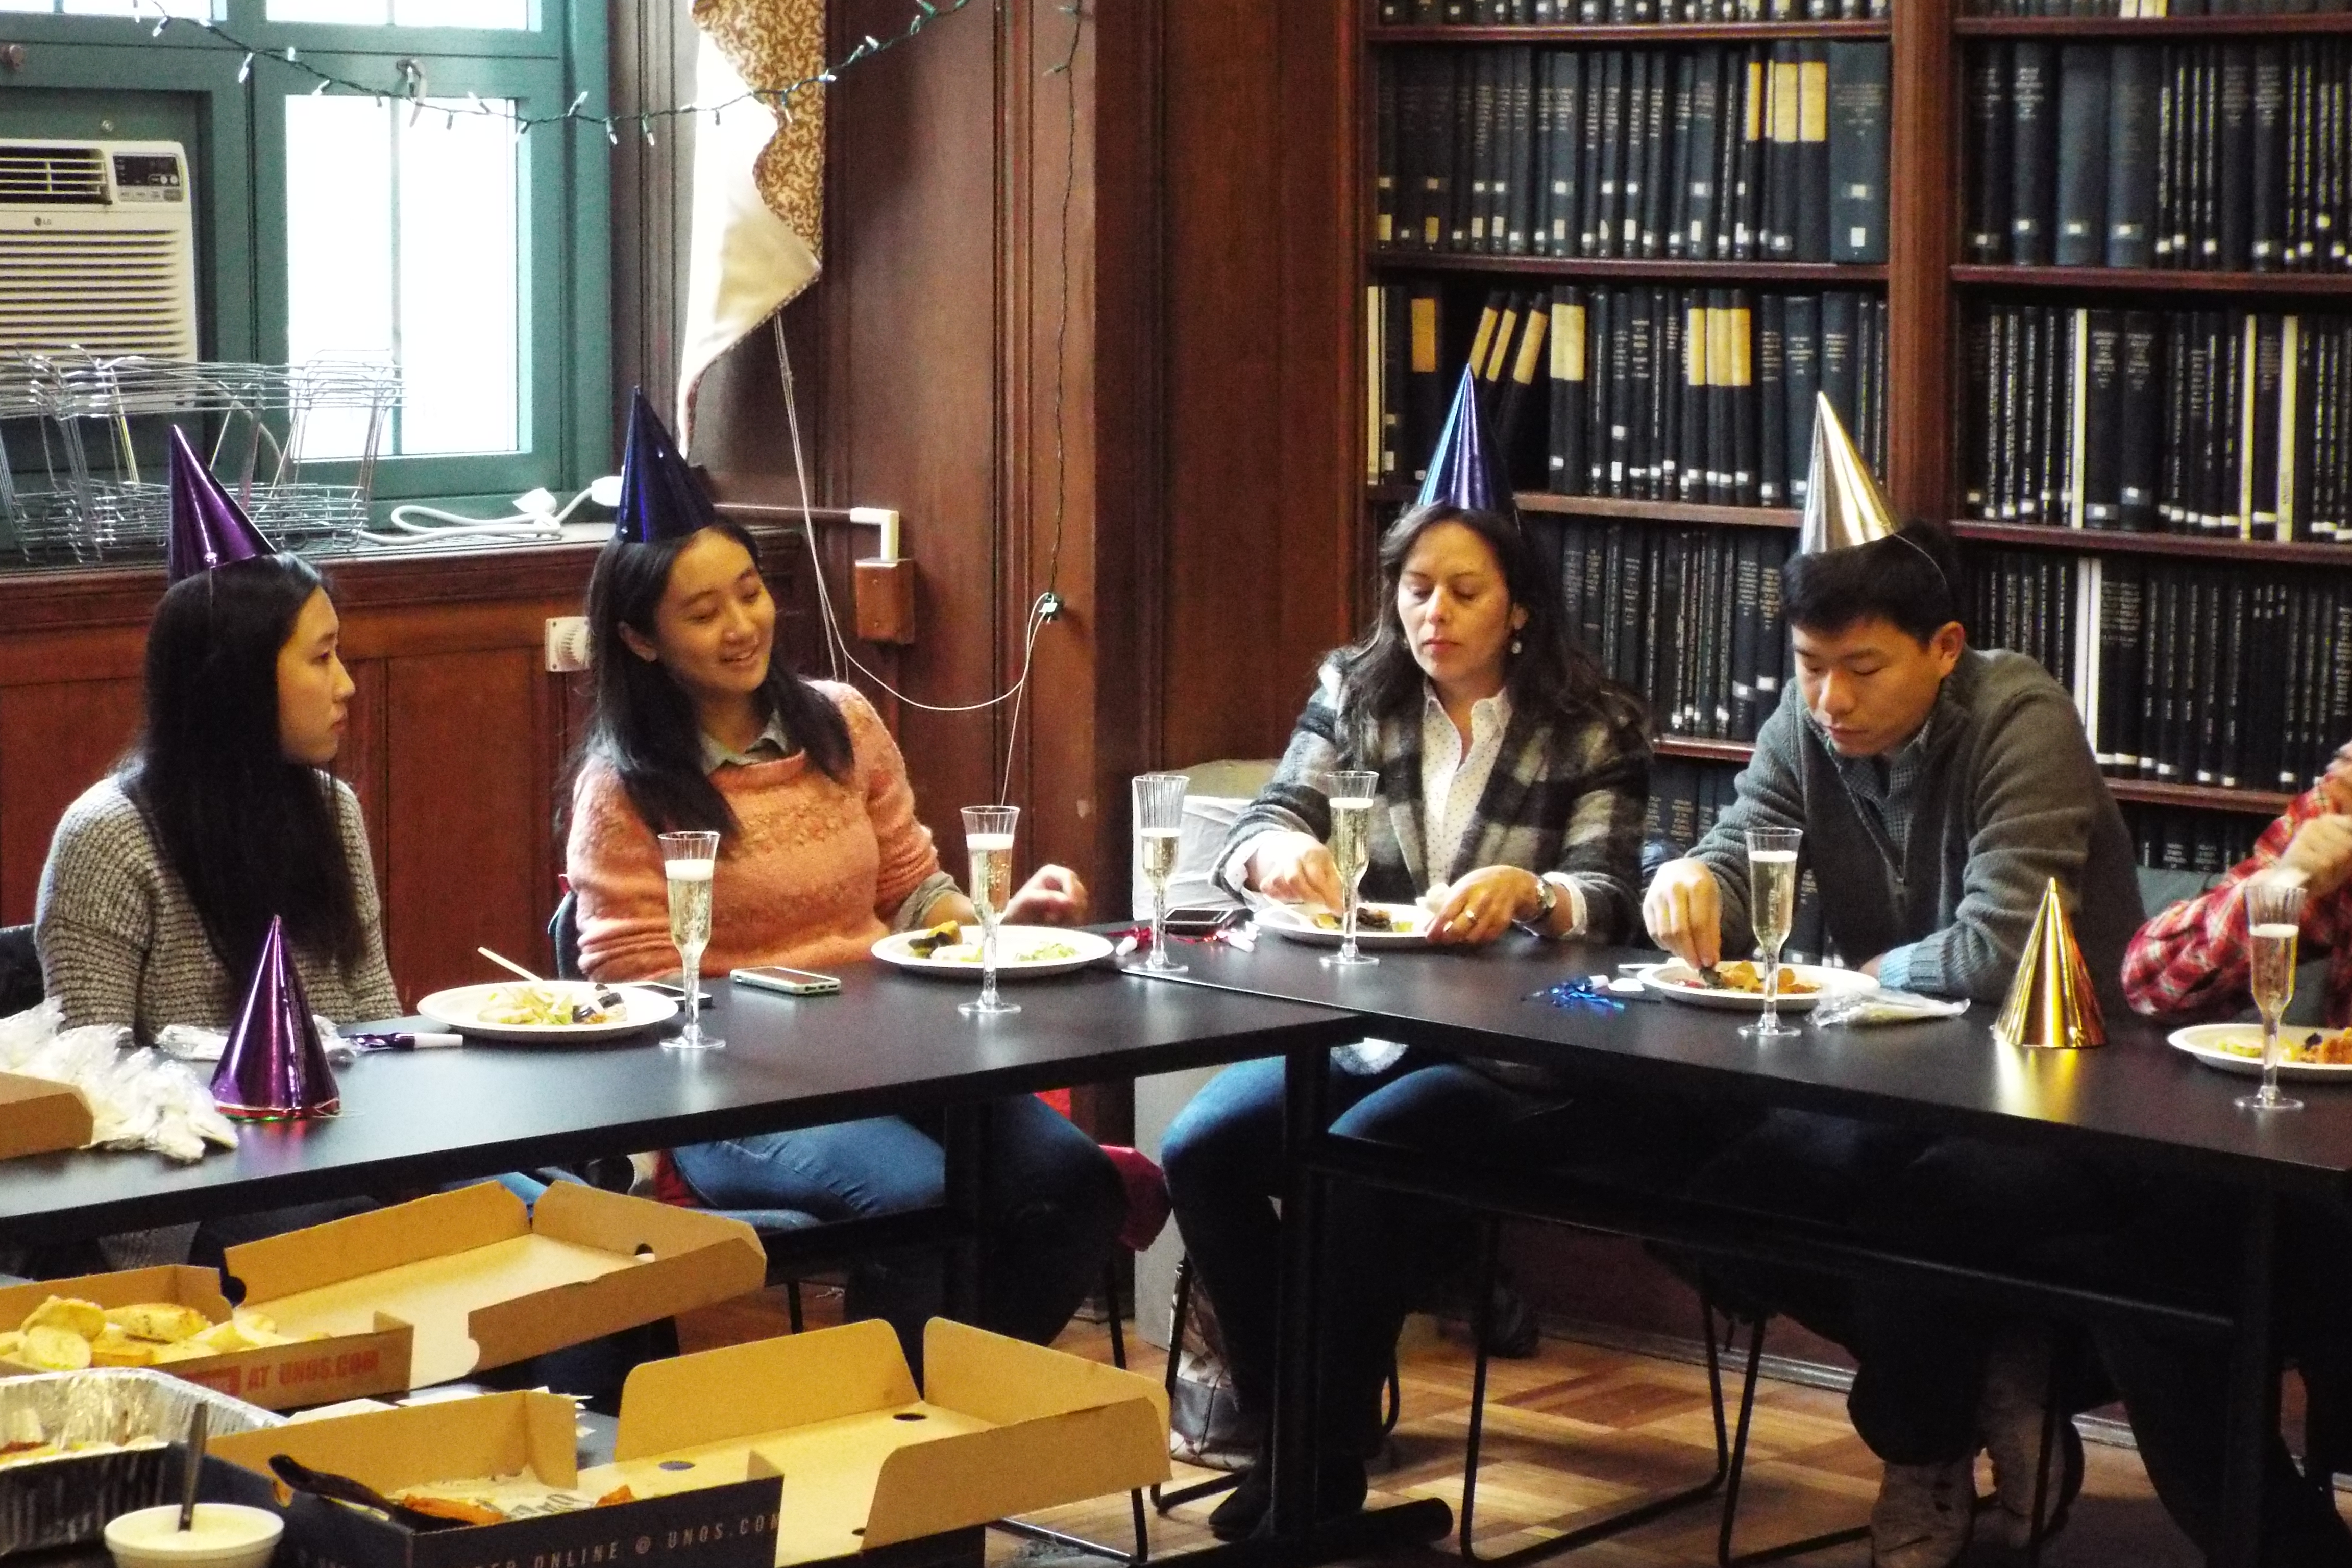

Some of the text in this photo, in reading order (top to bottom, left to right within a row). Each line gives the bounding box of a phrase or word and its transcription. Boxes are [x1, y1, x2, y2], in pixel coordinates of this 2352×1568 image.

[247, 1365, 270, 1392] AT
[278, 1349, 379, 1386] UNOS.COM
[534, 1540, 619, 1568] ONLINE
